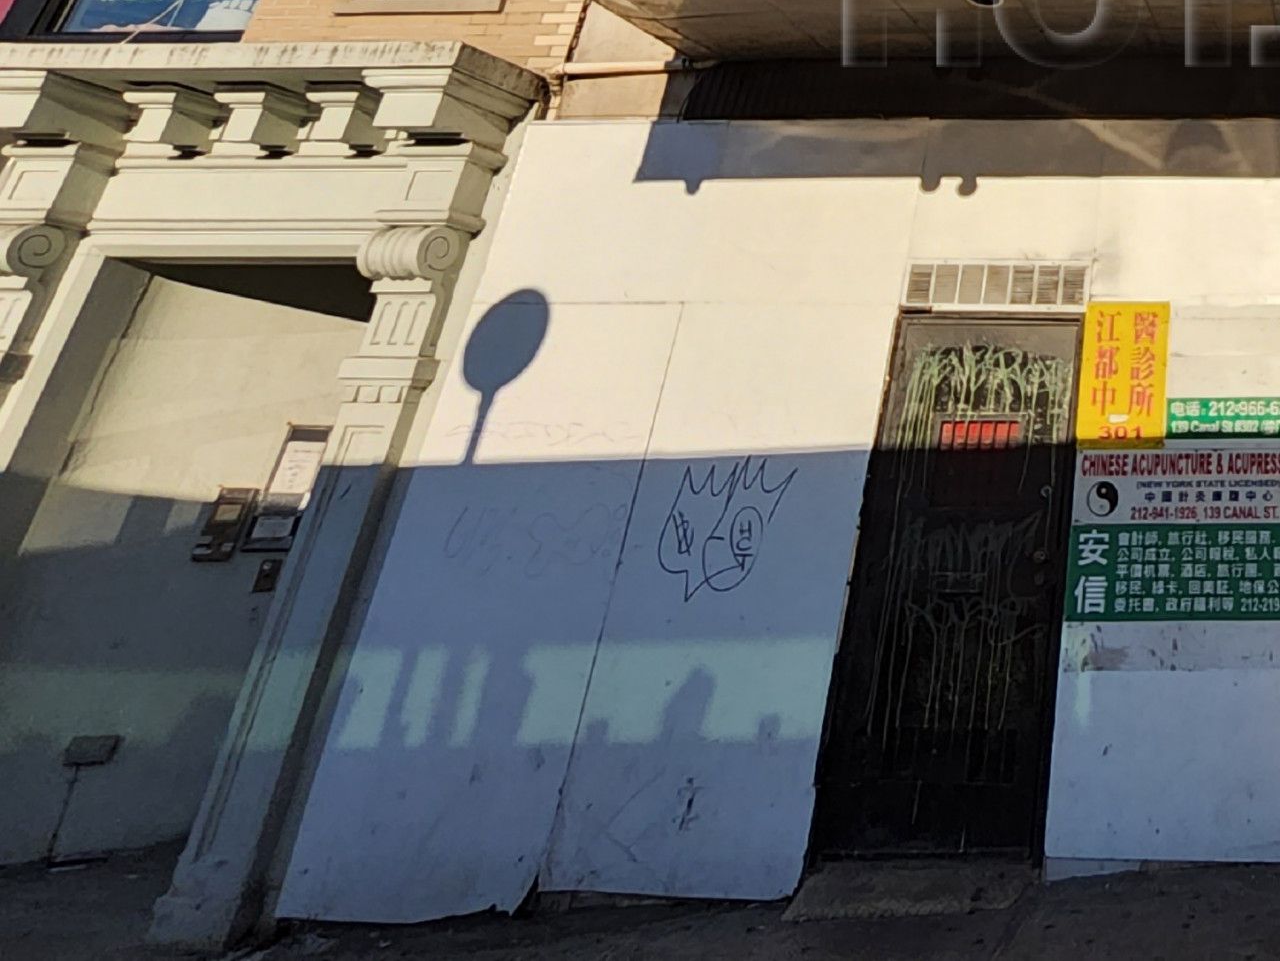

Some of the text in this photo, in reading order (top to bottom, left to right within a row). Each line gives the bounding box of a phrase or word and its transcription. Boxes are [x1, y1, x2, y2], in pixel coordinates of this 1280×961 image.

[1081, 454, 1129, 476] CHINESE
[1131, 453, 1213, 476] ACUPUNCTURE
[1216, 453, 1223, 475] &
[1165, 480, 1193, 489] YORK
[1195, 480, 1225, 489] STATE
[1204, 507, 1221, 520] 139
[1224, 506, 1260, 519] CANAL
[1074, 529, 1109, 614] 安信
